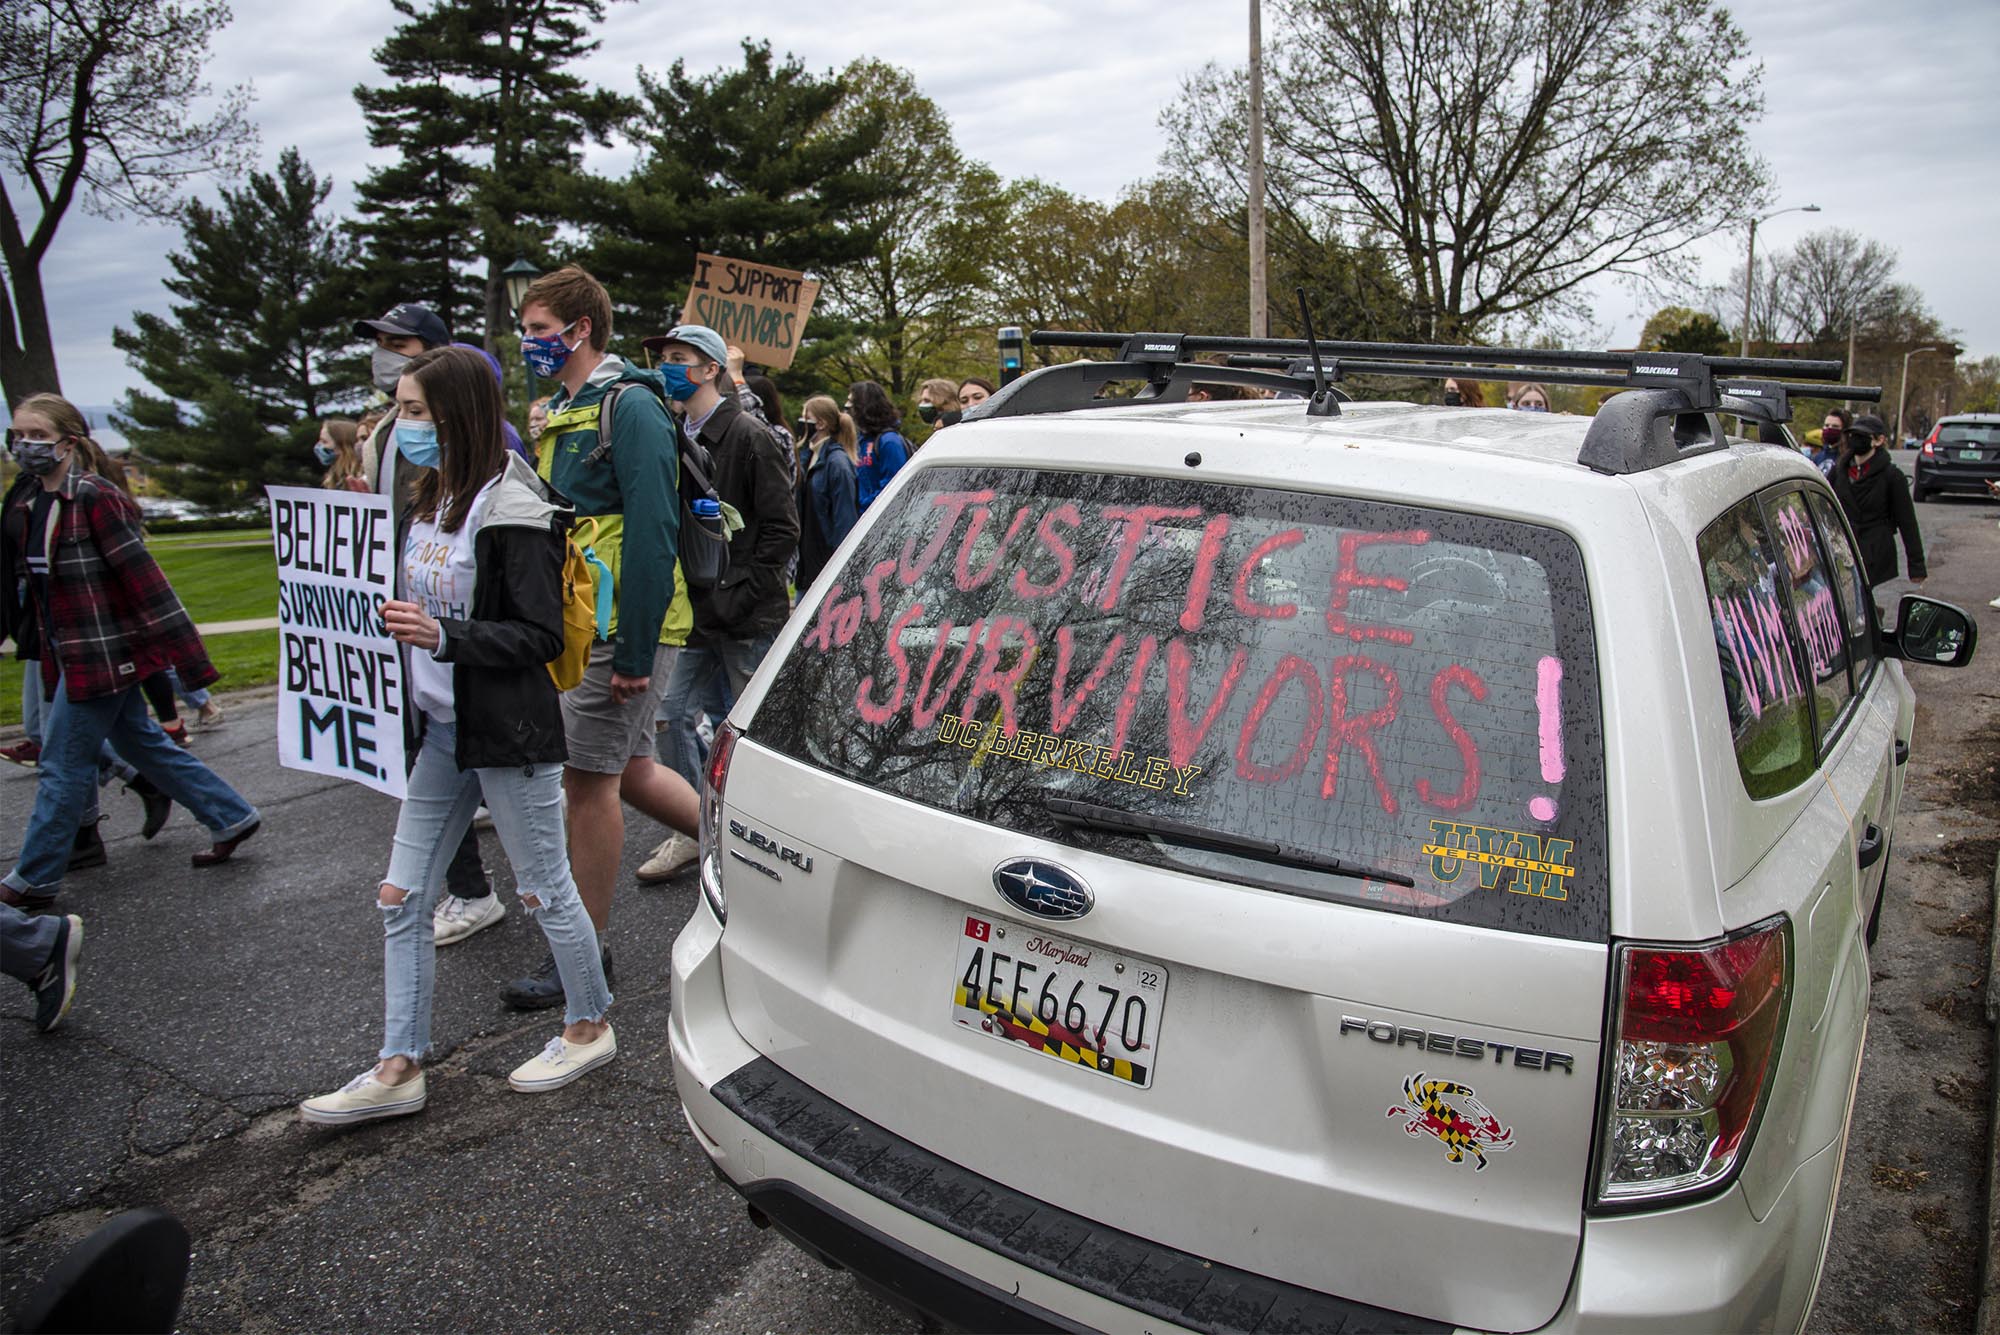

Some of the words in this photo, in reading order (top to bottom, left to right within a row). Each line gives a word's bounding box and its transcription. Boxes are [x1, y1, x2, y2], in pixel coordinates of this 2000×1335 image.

[694, 259, 712, 290] I
[718, 263, 802, 304] SUPPORT
[696, 294, 795, 349] SURVIVORS
[1635, 366, 1679, 376] YAKIMA
[1727, 388, 1762, 396] YAKIMA
[275, 499, 388, 584] BELIEVE
[898, 489, 1433, 646] JUSTICE
[279, 579, 393, 639] SURVIVORS
[406, 564, 457, 601] EALTH
[285, 632, 399, 716] BELIEVE
[298, 697, 388, 782] ME.
[938, 714, 982, 749] UC
[988, 725, 1202, 796] BERKELEY
[729, 818, 813, 873] SUBARU
[1424, 845, 1574, 876] VERMONT
[1429, 819, 1574, 901] UVM
[975, 922, 984, 938] 5
[1026, 937, 1092, 968] Maryland
[1141, 971, 1158, 987] 22
[1339, 1014, 1575, 1075] FORESTER
